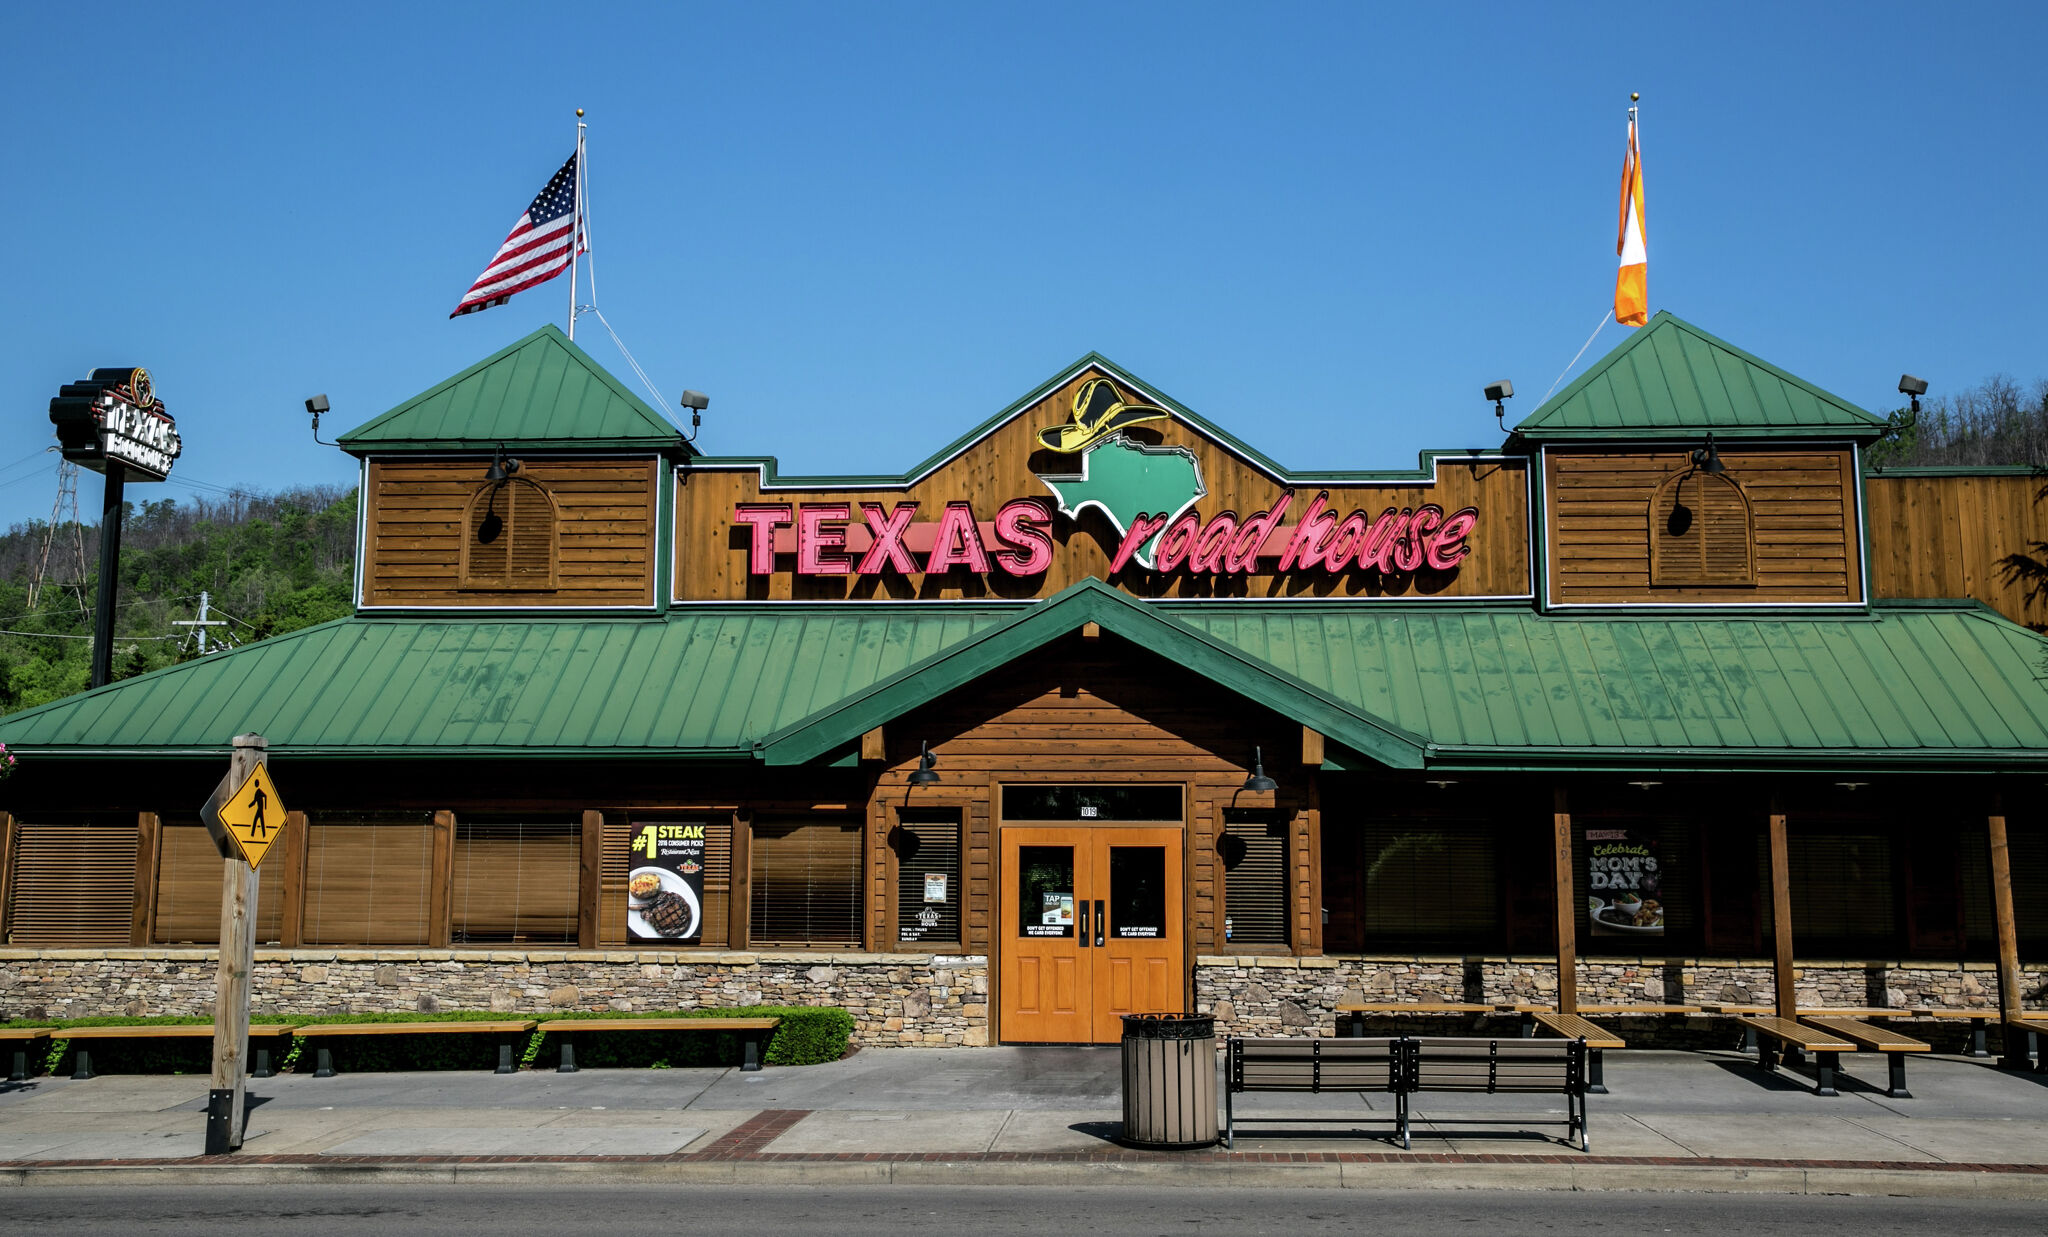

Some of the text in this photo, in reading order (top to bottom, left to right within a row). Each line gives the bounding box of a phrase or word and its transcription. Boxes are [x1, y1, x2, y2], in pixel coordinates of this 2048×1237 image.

[105, 396, 178, 455] TEXAS
[735, 487, 1480, 576] TEXAS road house
[1082, 807, 1097, 816] 1019
[631, 825, 705, 859] #1 STEAK
[1593, 843, 1649, 856] Celebrate
[1589, 857, 1658, 872] MOM'S
[1590, 871, 1643, 890] DAY
[919, 912, 939, 920] TEXAS
